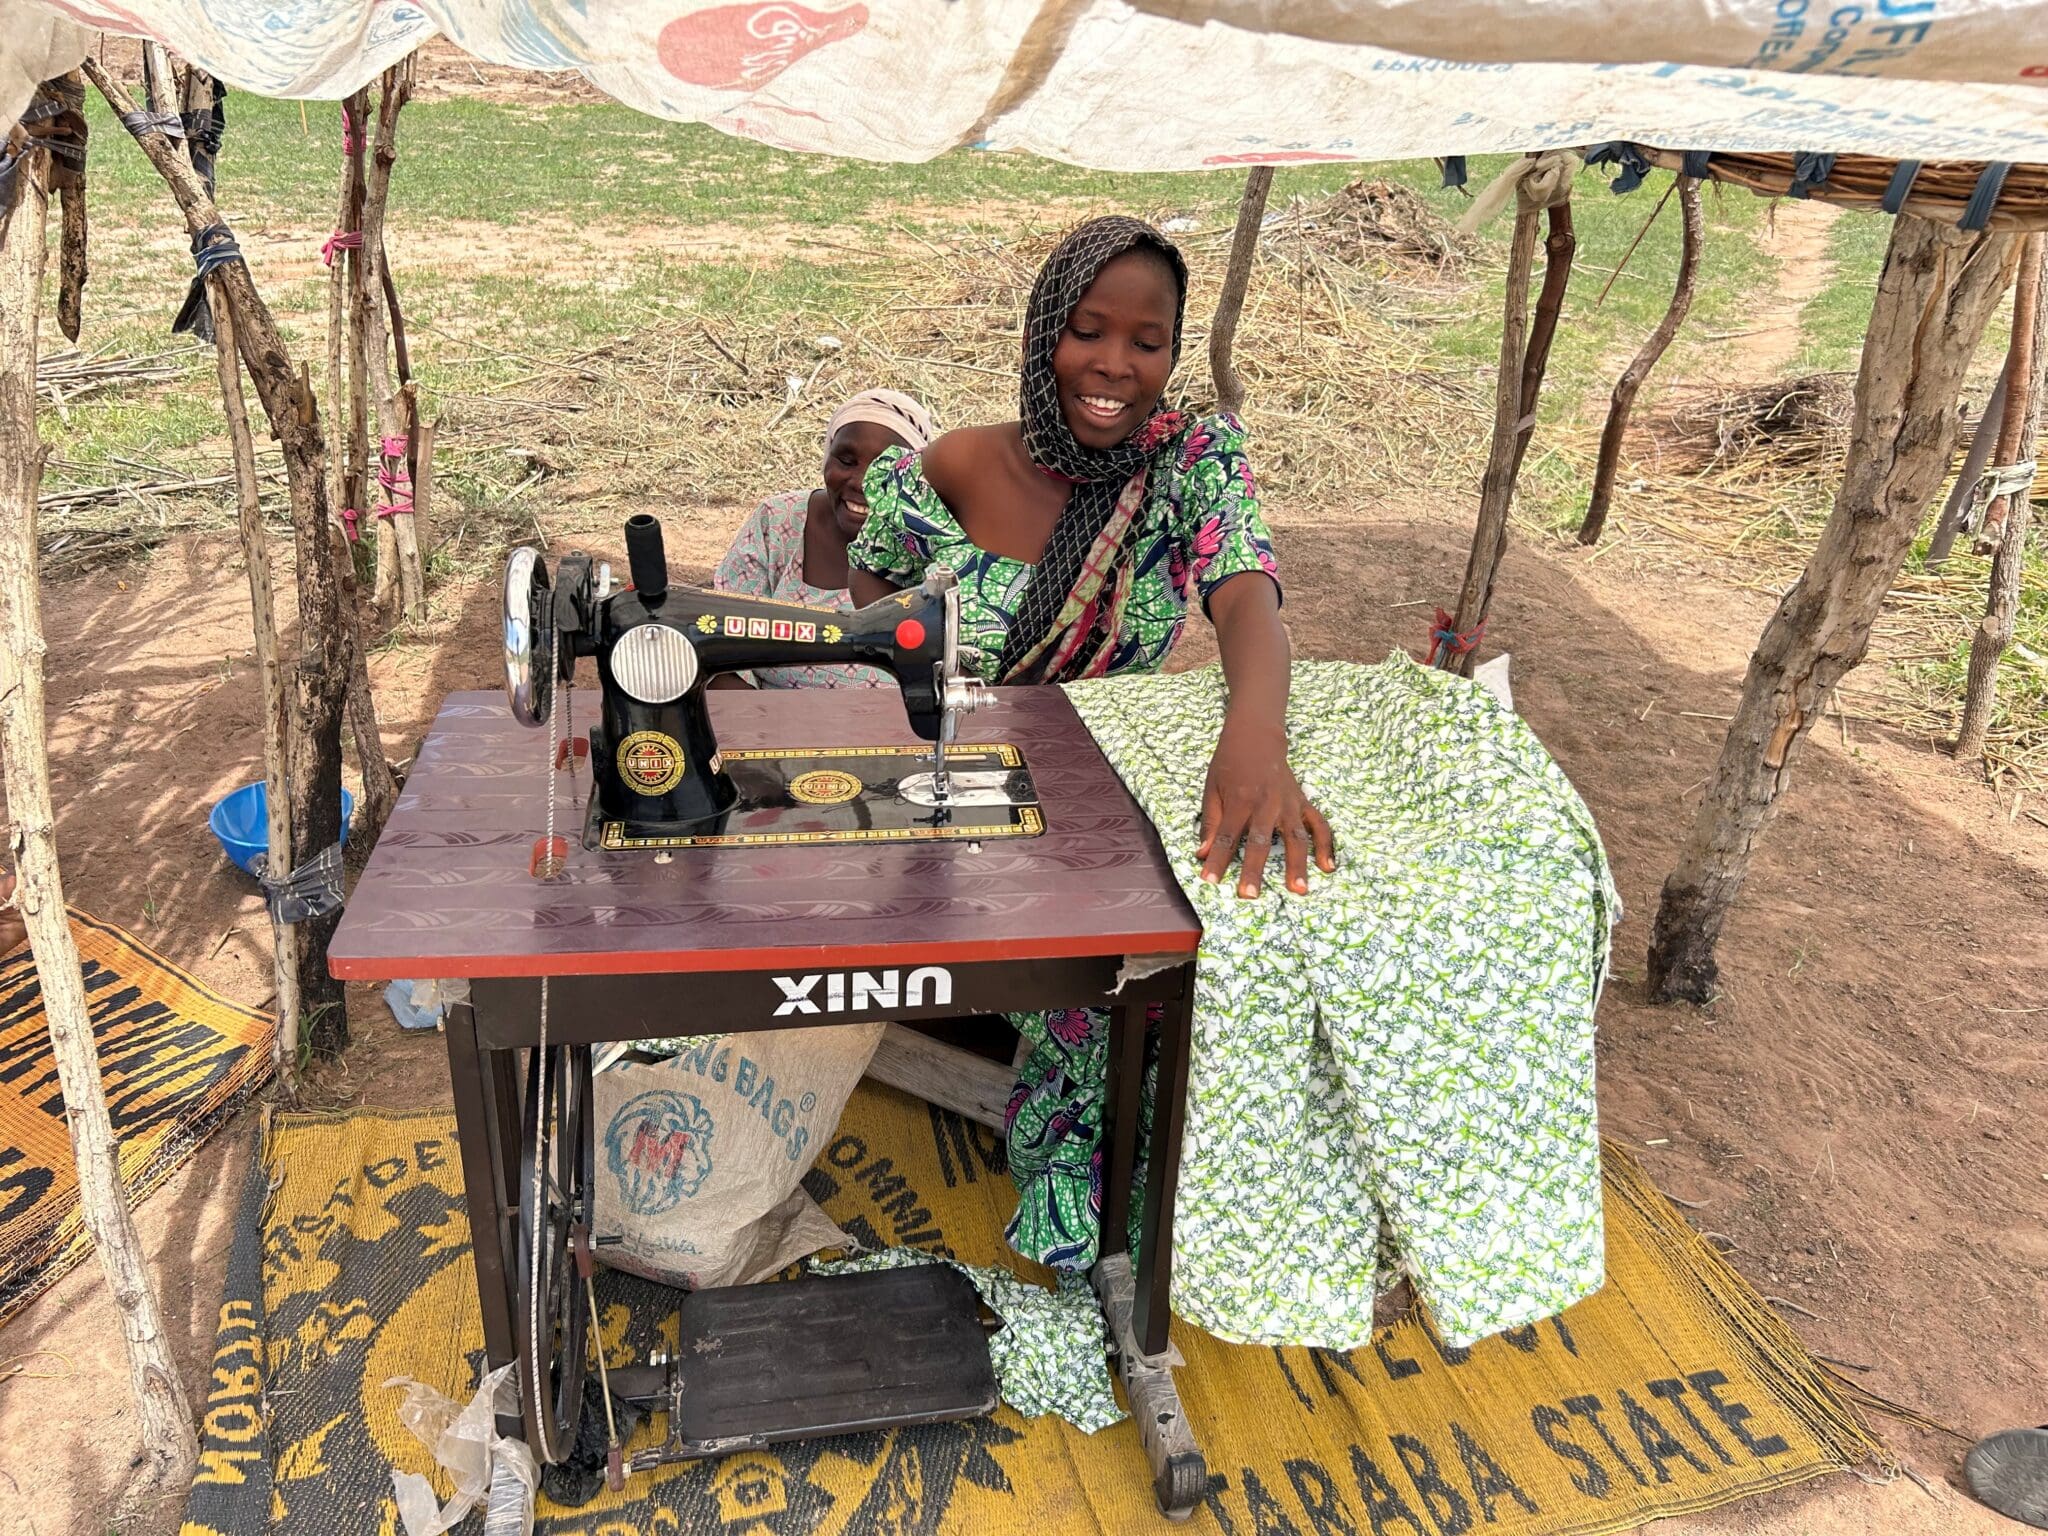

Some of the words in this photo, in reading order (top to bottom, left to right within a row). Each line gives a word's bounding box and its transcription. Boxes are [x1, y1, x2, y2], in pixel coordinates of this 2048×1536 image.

[727, 617, 815, 642] UNIX
[627, 758, 673, 768] UNIX
[771, 965, 953, 1017] UNIX
[734, 1056, 809, 1161] BAGS
[1203, 1421, 1540, 1536] TARABA
[1532, 1369, 1790, 1499] STATE
